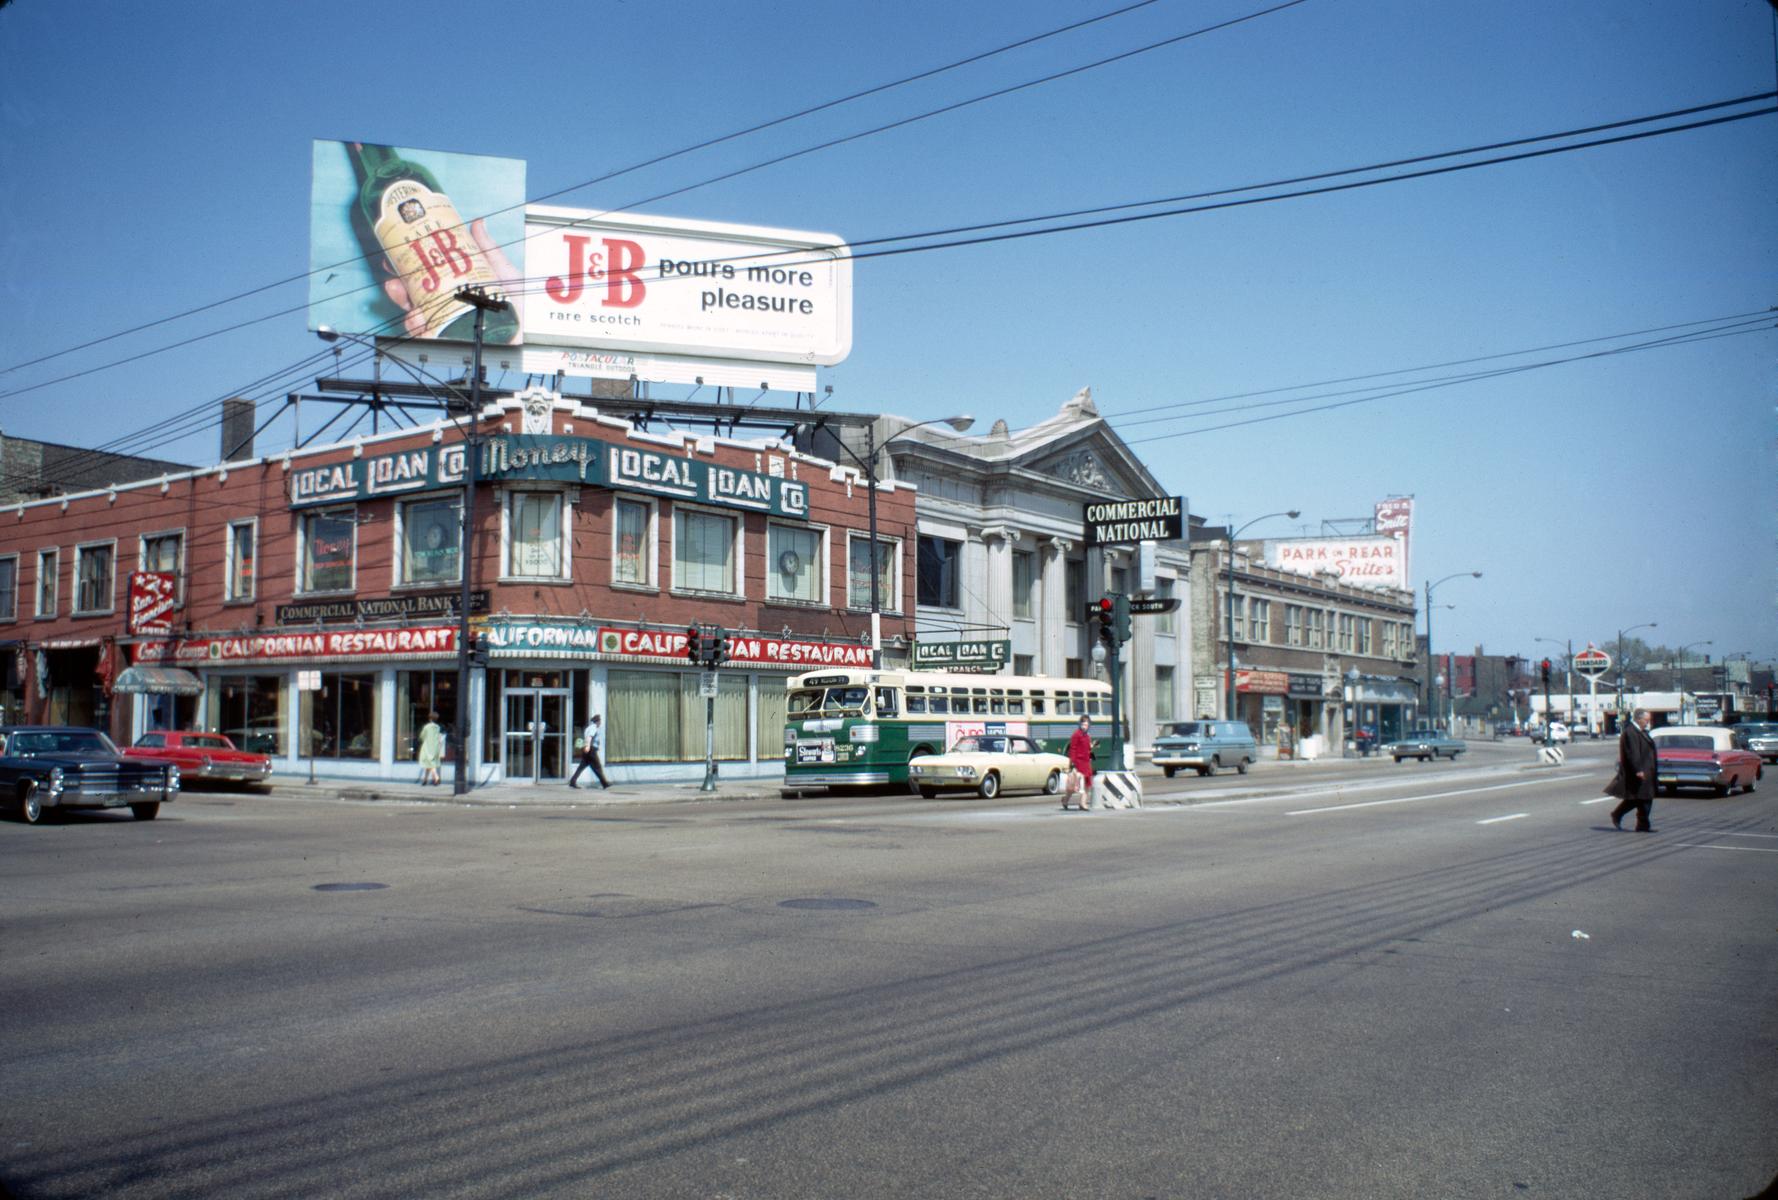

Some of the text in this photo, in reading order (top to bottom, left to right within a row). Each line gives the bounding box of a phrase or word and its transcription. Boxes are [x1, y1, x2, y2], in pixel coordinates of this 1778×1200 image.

[409, 228, 473, 294] J&B
[545, 234, 646, 309] J&B
[659, 257, 814, 287] pours more
[702, 287, 814, 315] pleasure
[550, 312, 641, 326] rare scotch
[481, 437, 597, 480] Money
[292, 463, 358, 504] LOCAL
[368, 450, 429, 494] LOAN
[609, 447, 698, 497] LOCAL
[708, 467, 771, 510] LOAN
[1087, 499, 1179, 522] COMMERCIAL
[1096, 520, 1169, 543] NATIONAL
[1282, 547, 1328, 561] PARK
[1349, 545, 1393, 559] REAR
[280, 603, 352, 621] COMMERCIAL
[357, 598, 416, 616] NATIONAL
[417, 596, 454, 613] BANK
[1142, 602, 1163, 611] SOUTH
[222, 628, 452, 658] CALIFORNIAN RESTAURANT
[625, 632, 873, 665] CALIFIAN RESTAURANT
[916, 644, 953, 661] LOCAL
[957, 643, 988, 661] LOAN
[1575, 659, 1608, 667] STANDARD
